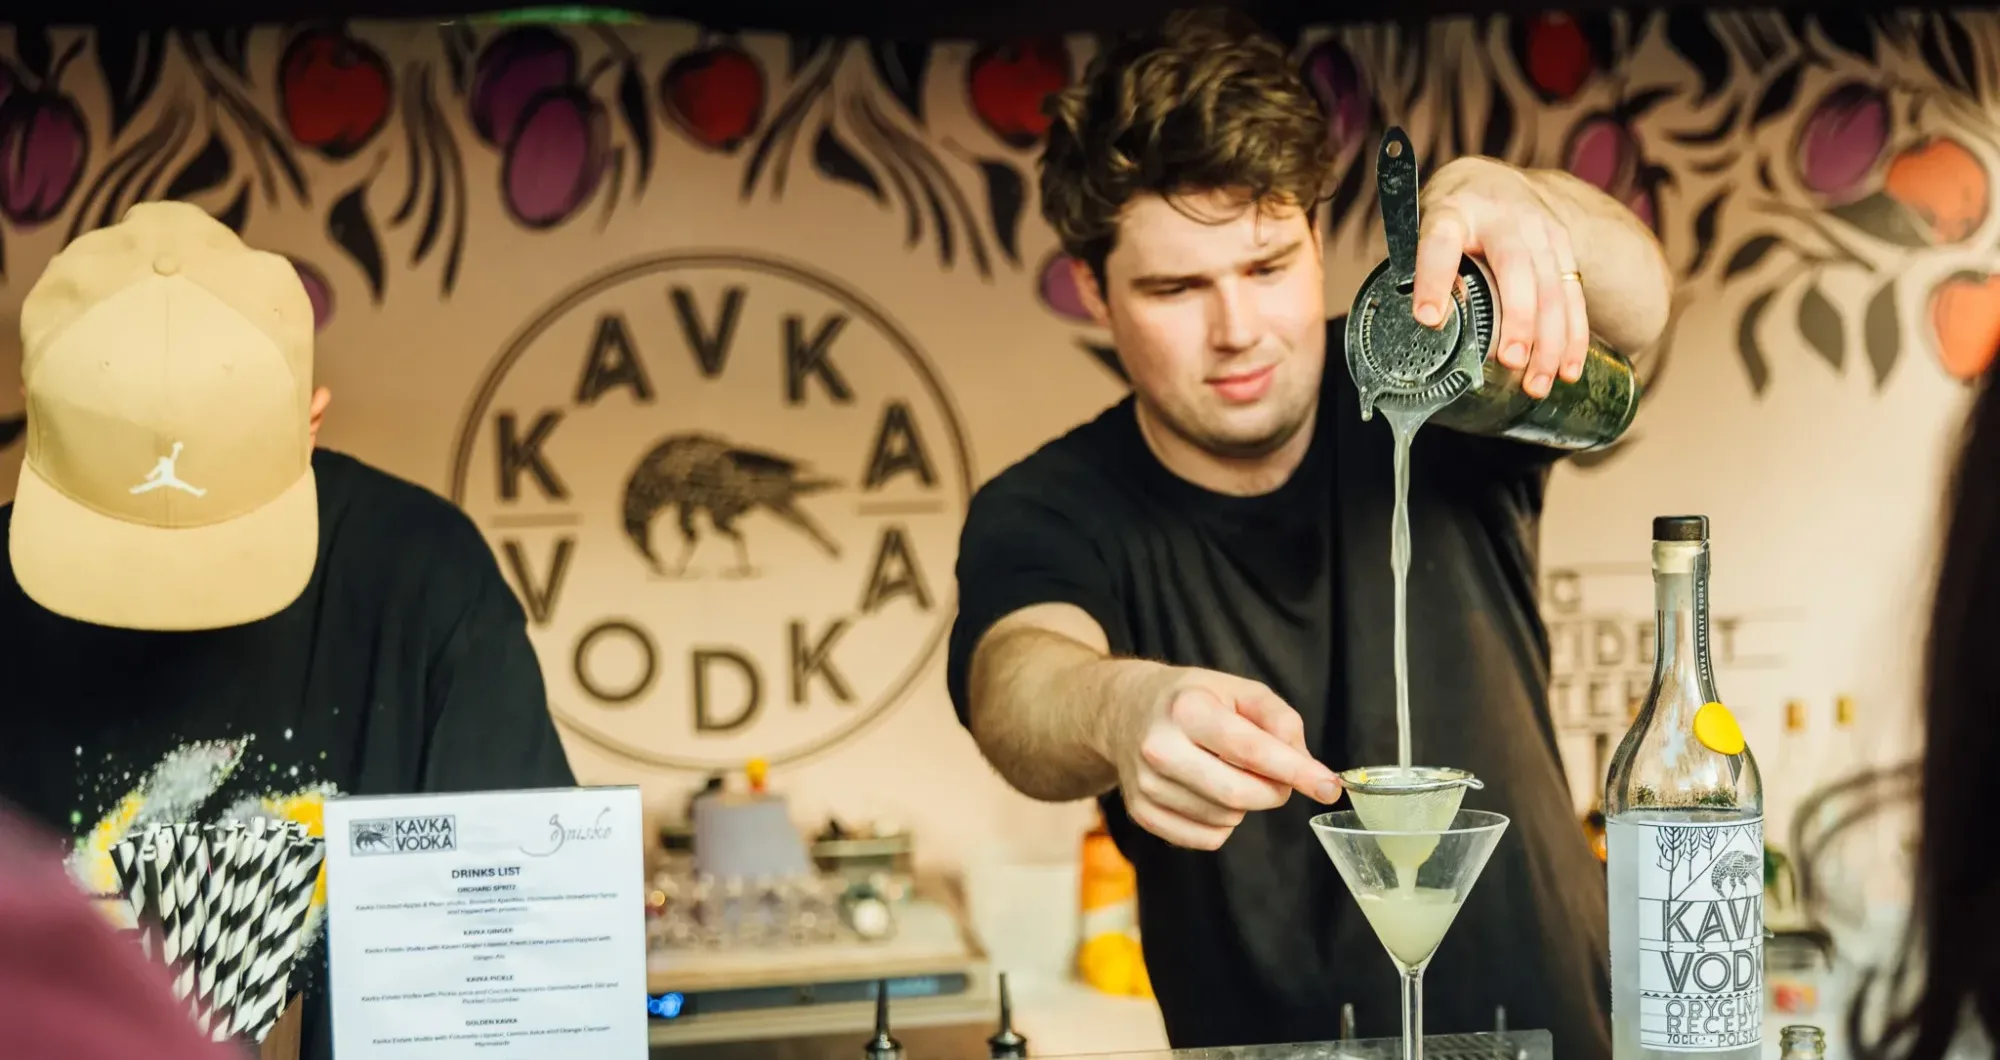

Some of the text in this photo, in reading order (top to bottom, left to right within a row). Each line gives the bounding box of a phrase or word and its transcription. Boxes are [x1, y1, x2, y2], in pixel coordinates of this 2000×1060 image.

[493, 283, 939, 502] KAVKA
[500, 527, 934, 734] VODKA
[1698, 614, 1706, 647] ESTATE
[1700, 650, 1708, 680] KAVKA
[395, 818, 452, 835] KAVKA
[395, 834, 453, 851] VODKA
[451, 866, 521, 879] DRINKS LIST
